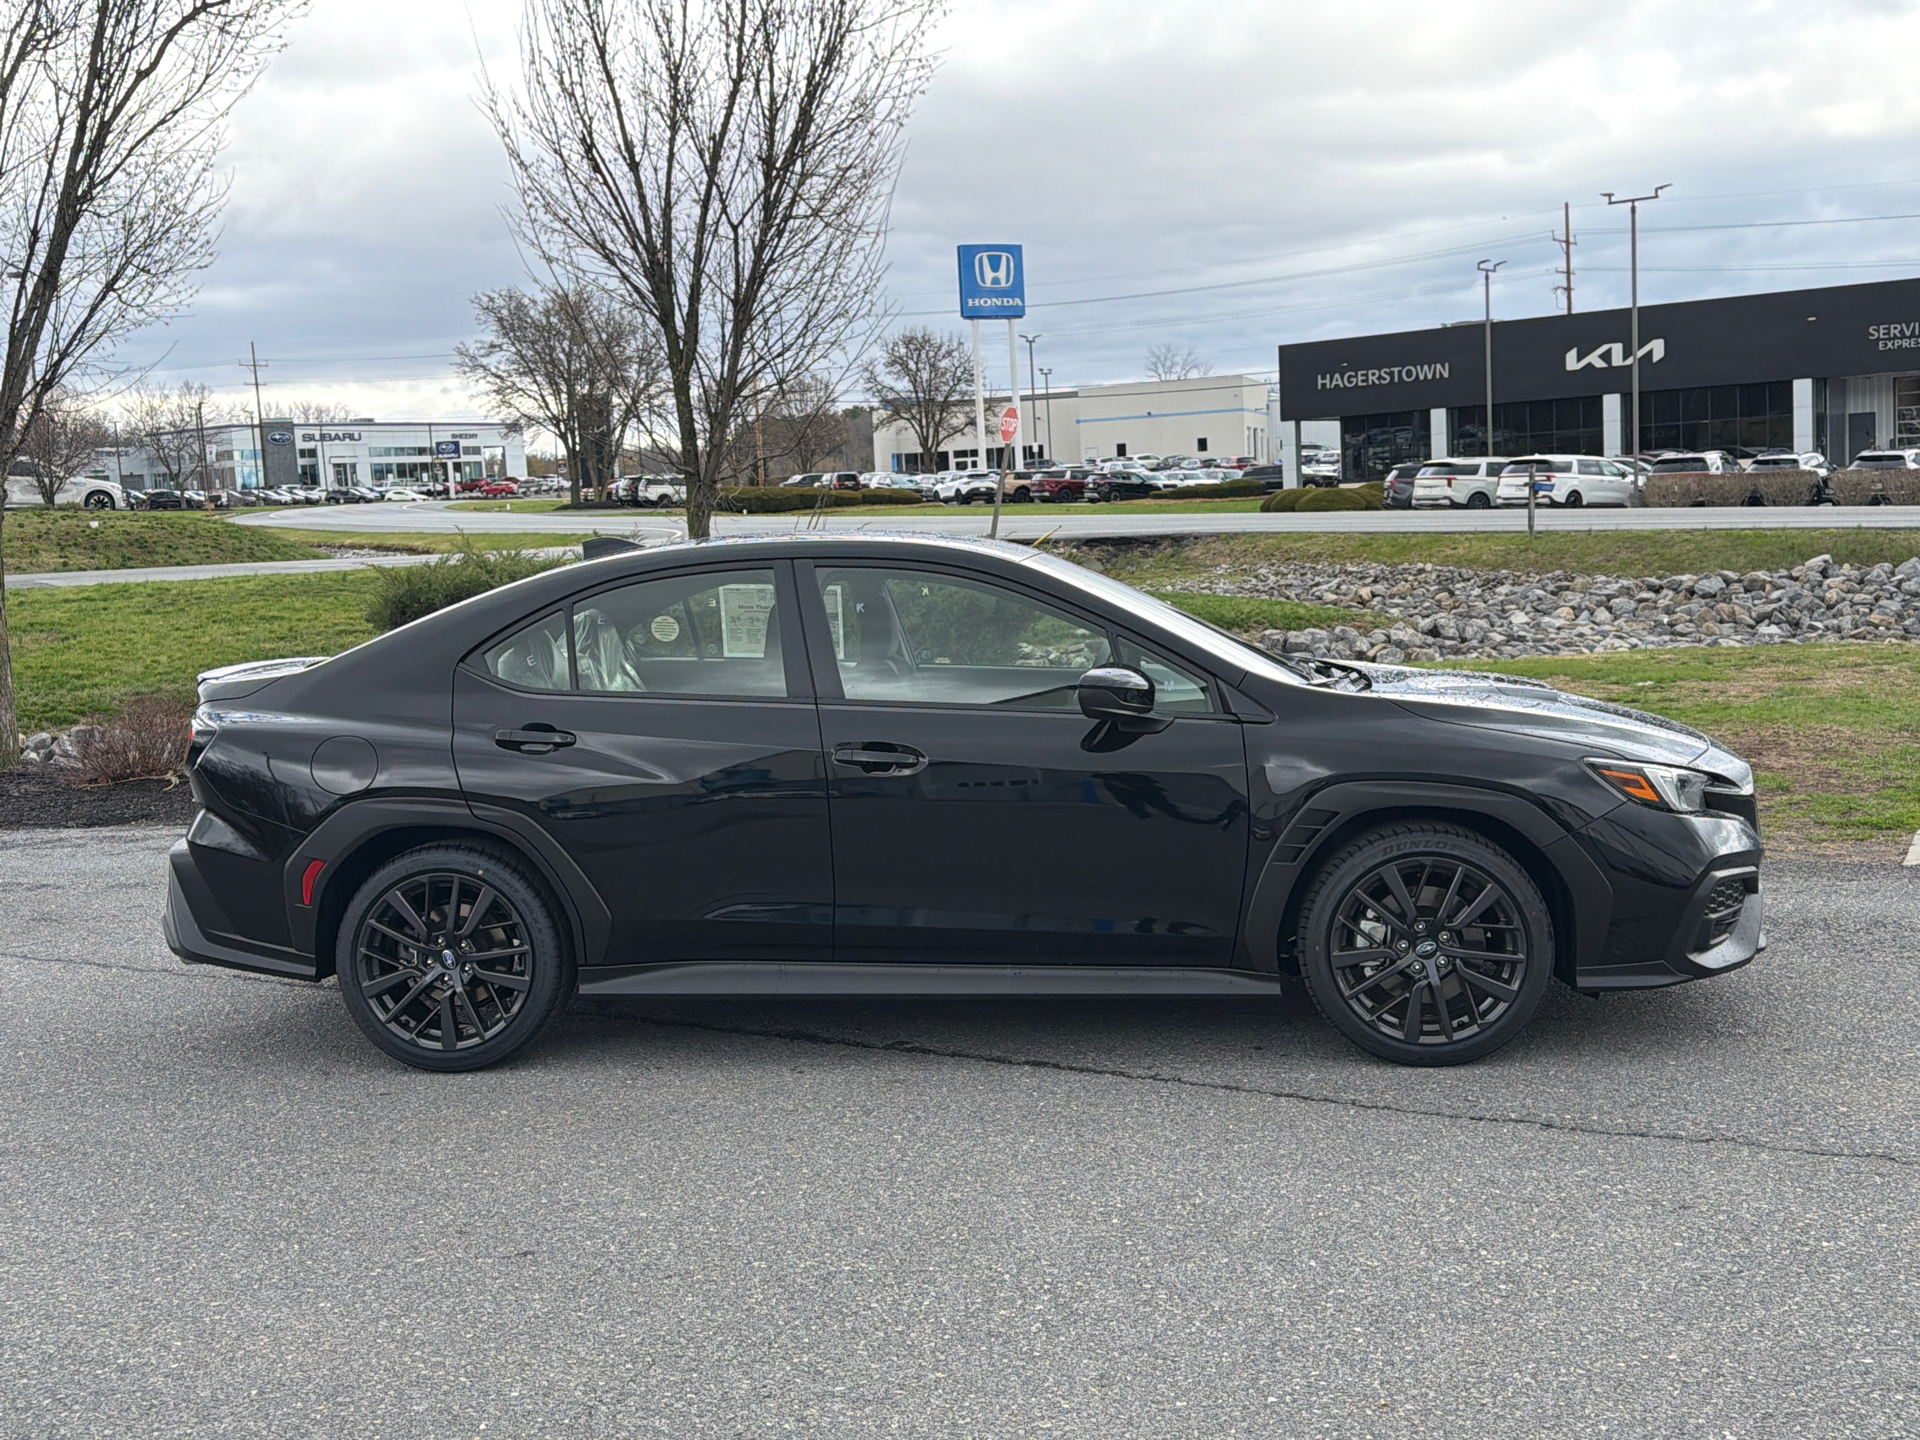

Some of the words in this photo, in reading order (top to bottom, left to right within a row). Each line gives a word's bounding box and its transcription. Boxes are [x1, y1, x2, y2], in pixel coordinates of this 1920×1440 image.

[966, 298, 1023, 307] HONDA
[1878, 338, 1920, 351] EXPRE
[1317, 362, 1449, 390] HAGERSTOWN
[1001, 417, 1018, 432] STOP
[301, 433, 362, 442] SUBARU
[856, 603, 866, 613] K
[526, 654, 537, 667] E
[1163, 680, 1175, 692] M
[1382, 839, 1464, 857] DUNLOP
